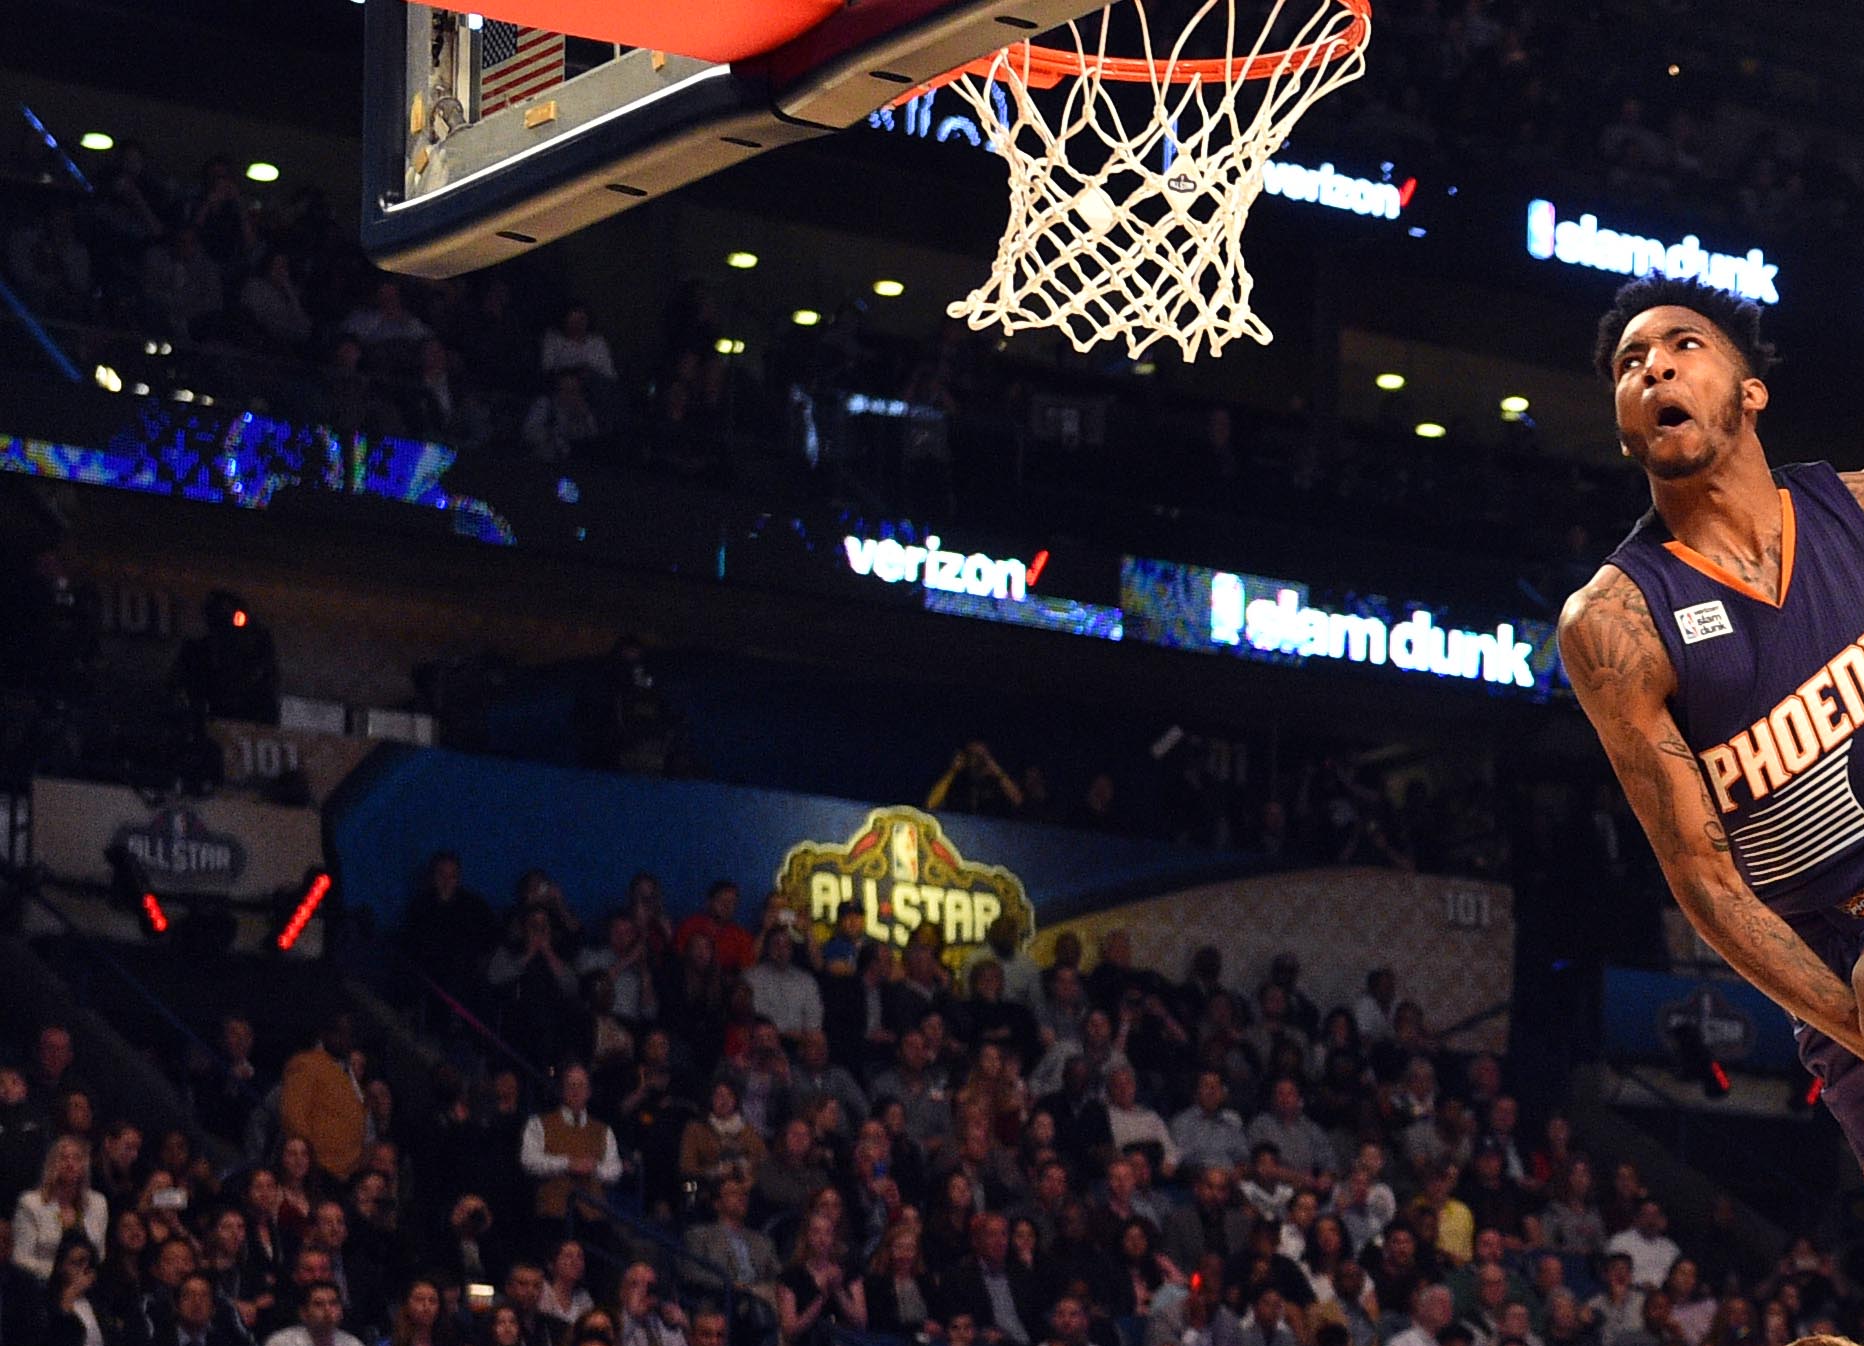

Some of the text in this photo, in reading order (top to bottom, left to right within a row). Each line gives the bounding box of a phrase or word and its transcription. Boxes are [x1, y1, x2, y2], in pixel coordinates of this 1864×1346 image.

[1262, 159, 1400, 219] verizon
[844, 535, 1027, 601] verizon
[1697, 613, 1722, 626] slam
[1700, 621, 1727, 635] dunk
[1446, 891, 1490, 926] 101
